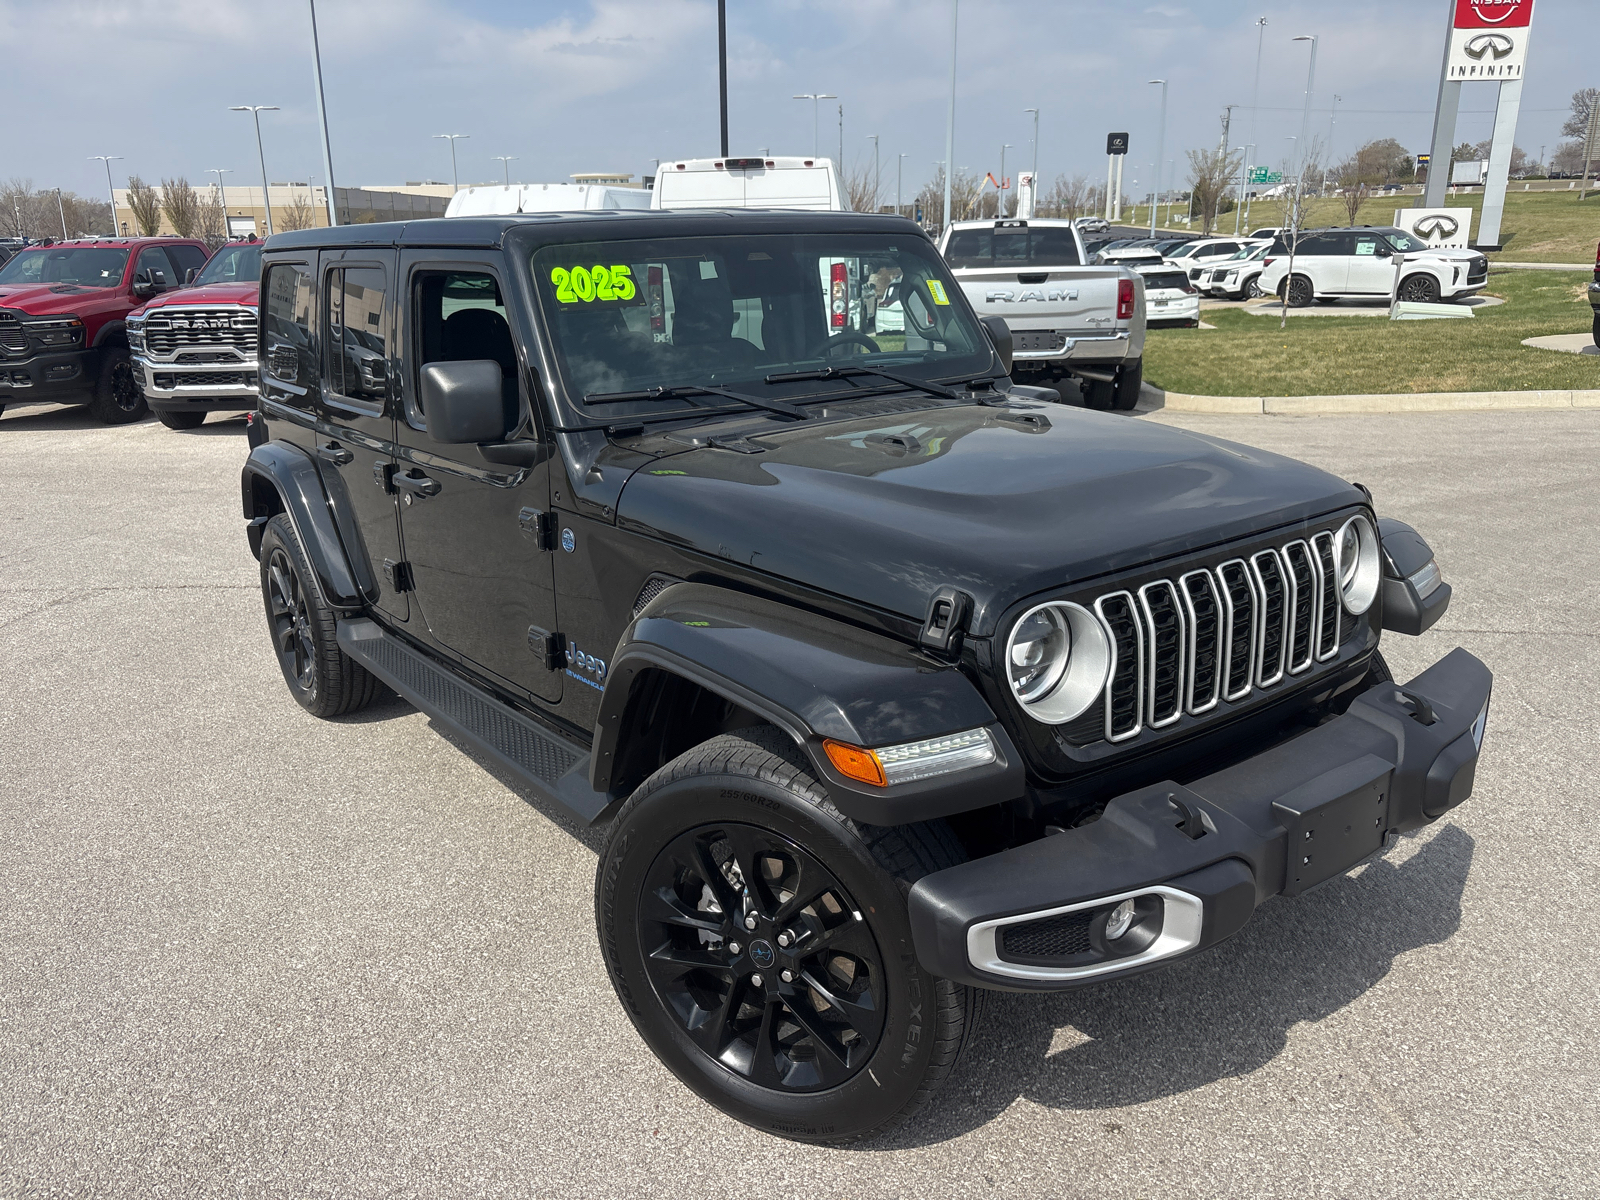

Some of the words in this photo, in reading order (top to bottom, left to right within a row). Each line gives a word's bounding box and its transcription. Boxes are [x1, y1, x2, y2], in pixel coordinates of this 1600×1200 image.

[1450, 64, 1522, 77] INFINITI
[551, 264, 636, 303] 2025
[986, 289, 1079, 303] RAM
[172, 319, 232, 329] RAM
[565, 641, 608, 682] Jeep
[572, 671, 605, 692] WRANGLE
[719, 789, 781, 811] 255/60R20
[901, 952, 923, 1065] NEXEN
